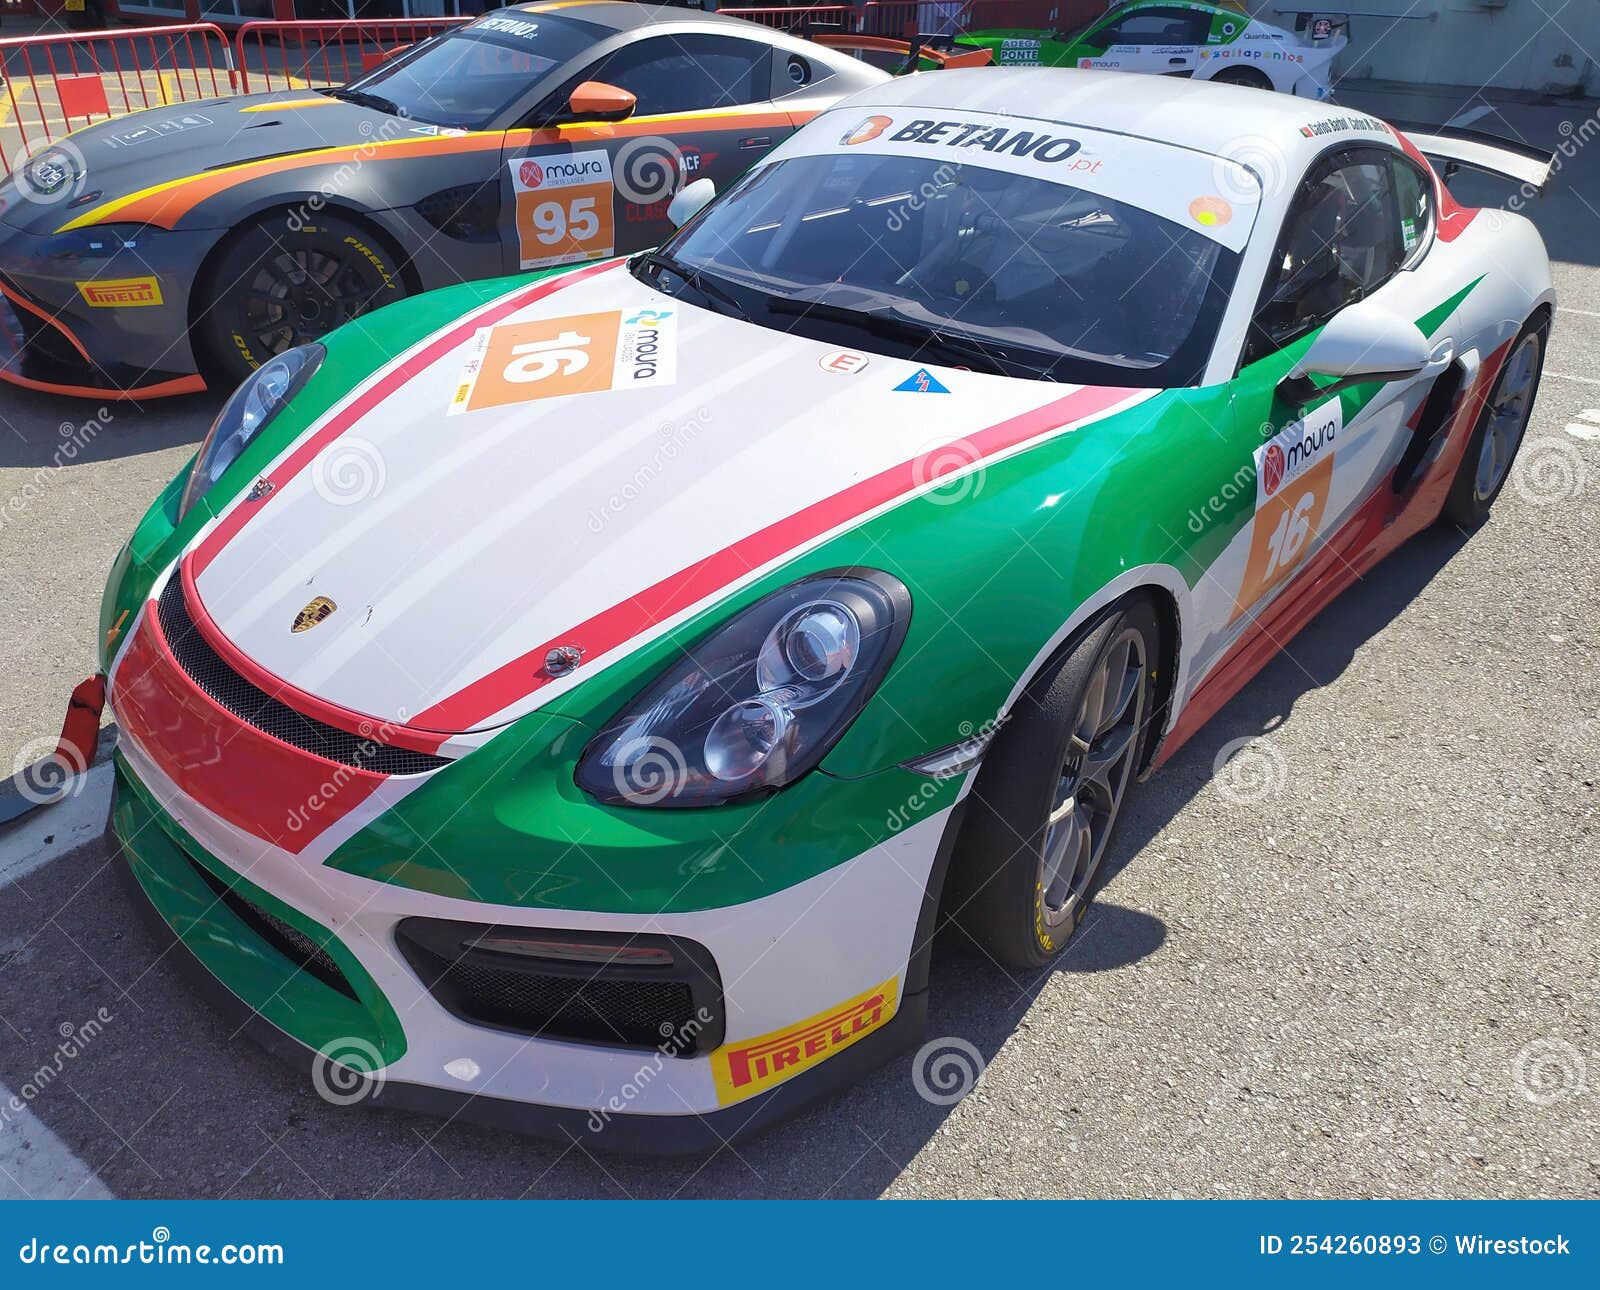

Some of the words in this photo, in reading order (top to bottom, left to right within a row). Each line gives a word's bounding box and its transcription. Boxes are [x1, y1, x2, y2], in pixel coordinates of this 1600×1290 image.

[475, 18, 538, 36] BETANO
[1002, 40, 1041, 48] ADEGA
[1002, 50, 1038, 59] PONTE
[679, 155, 700, 171] ACF
[888, 120, 1082, 163] BETANO
[546, 161, 602, 179] moura
[532, 197, 600, 245] 95
[343, 236, 396, 289] PIRELLI
[86, 283, 154, 304] PIRELLI
[503, 331, 591, 384] 16
[633, 329, 659, 379] moura
[830, 353, 862, 371] E
[1287, 420, 1336, 470] moura
[1263, 491, 1315, 583] 16
[727, 993, 885, 1088] PIRELLI
